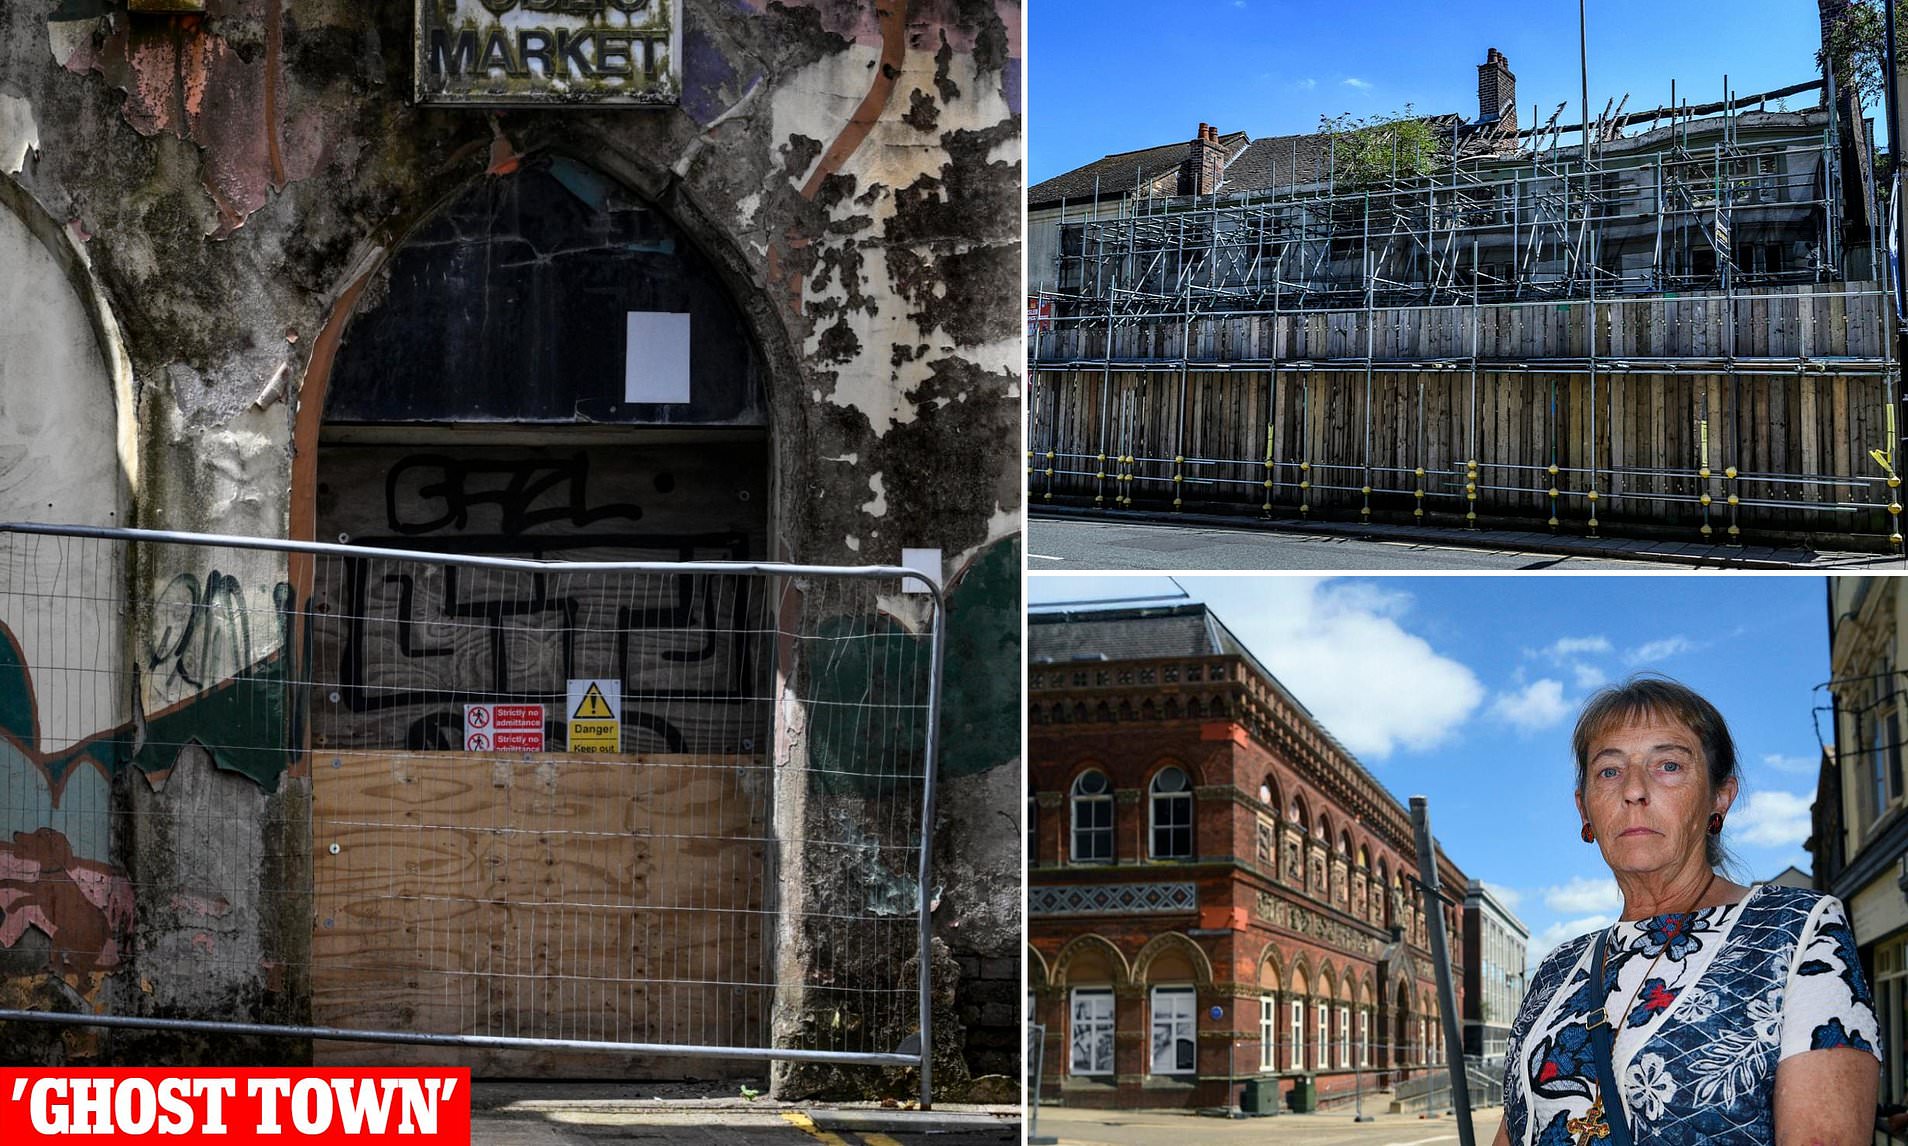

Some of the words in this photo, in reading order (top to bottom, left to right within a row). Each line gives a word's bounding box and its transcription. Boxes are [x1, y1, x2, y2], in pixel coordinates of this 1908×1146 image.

[430, 27, 669, 76] MARKET
[497, 709, 526, 718] Strictly
[496, 719, 541, 727] admittance
[574, 724, 615, 735] Danger
[497, 735, 526, 744] Strictly
[574, 744, 597, 752] Keep
